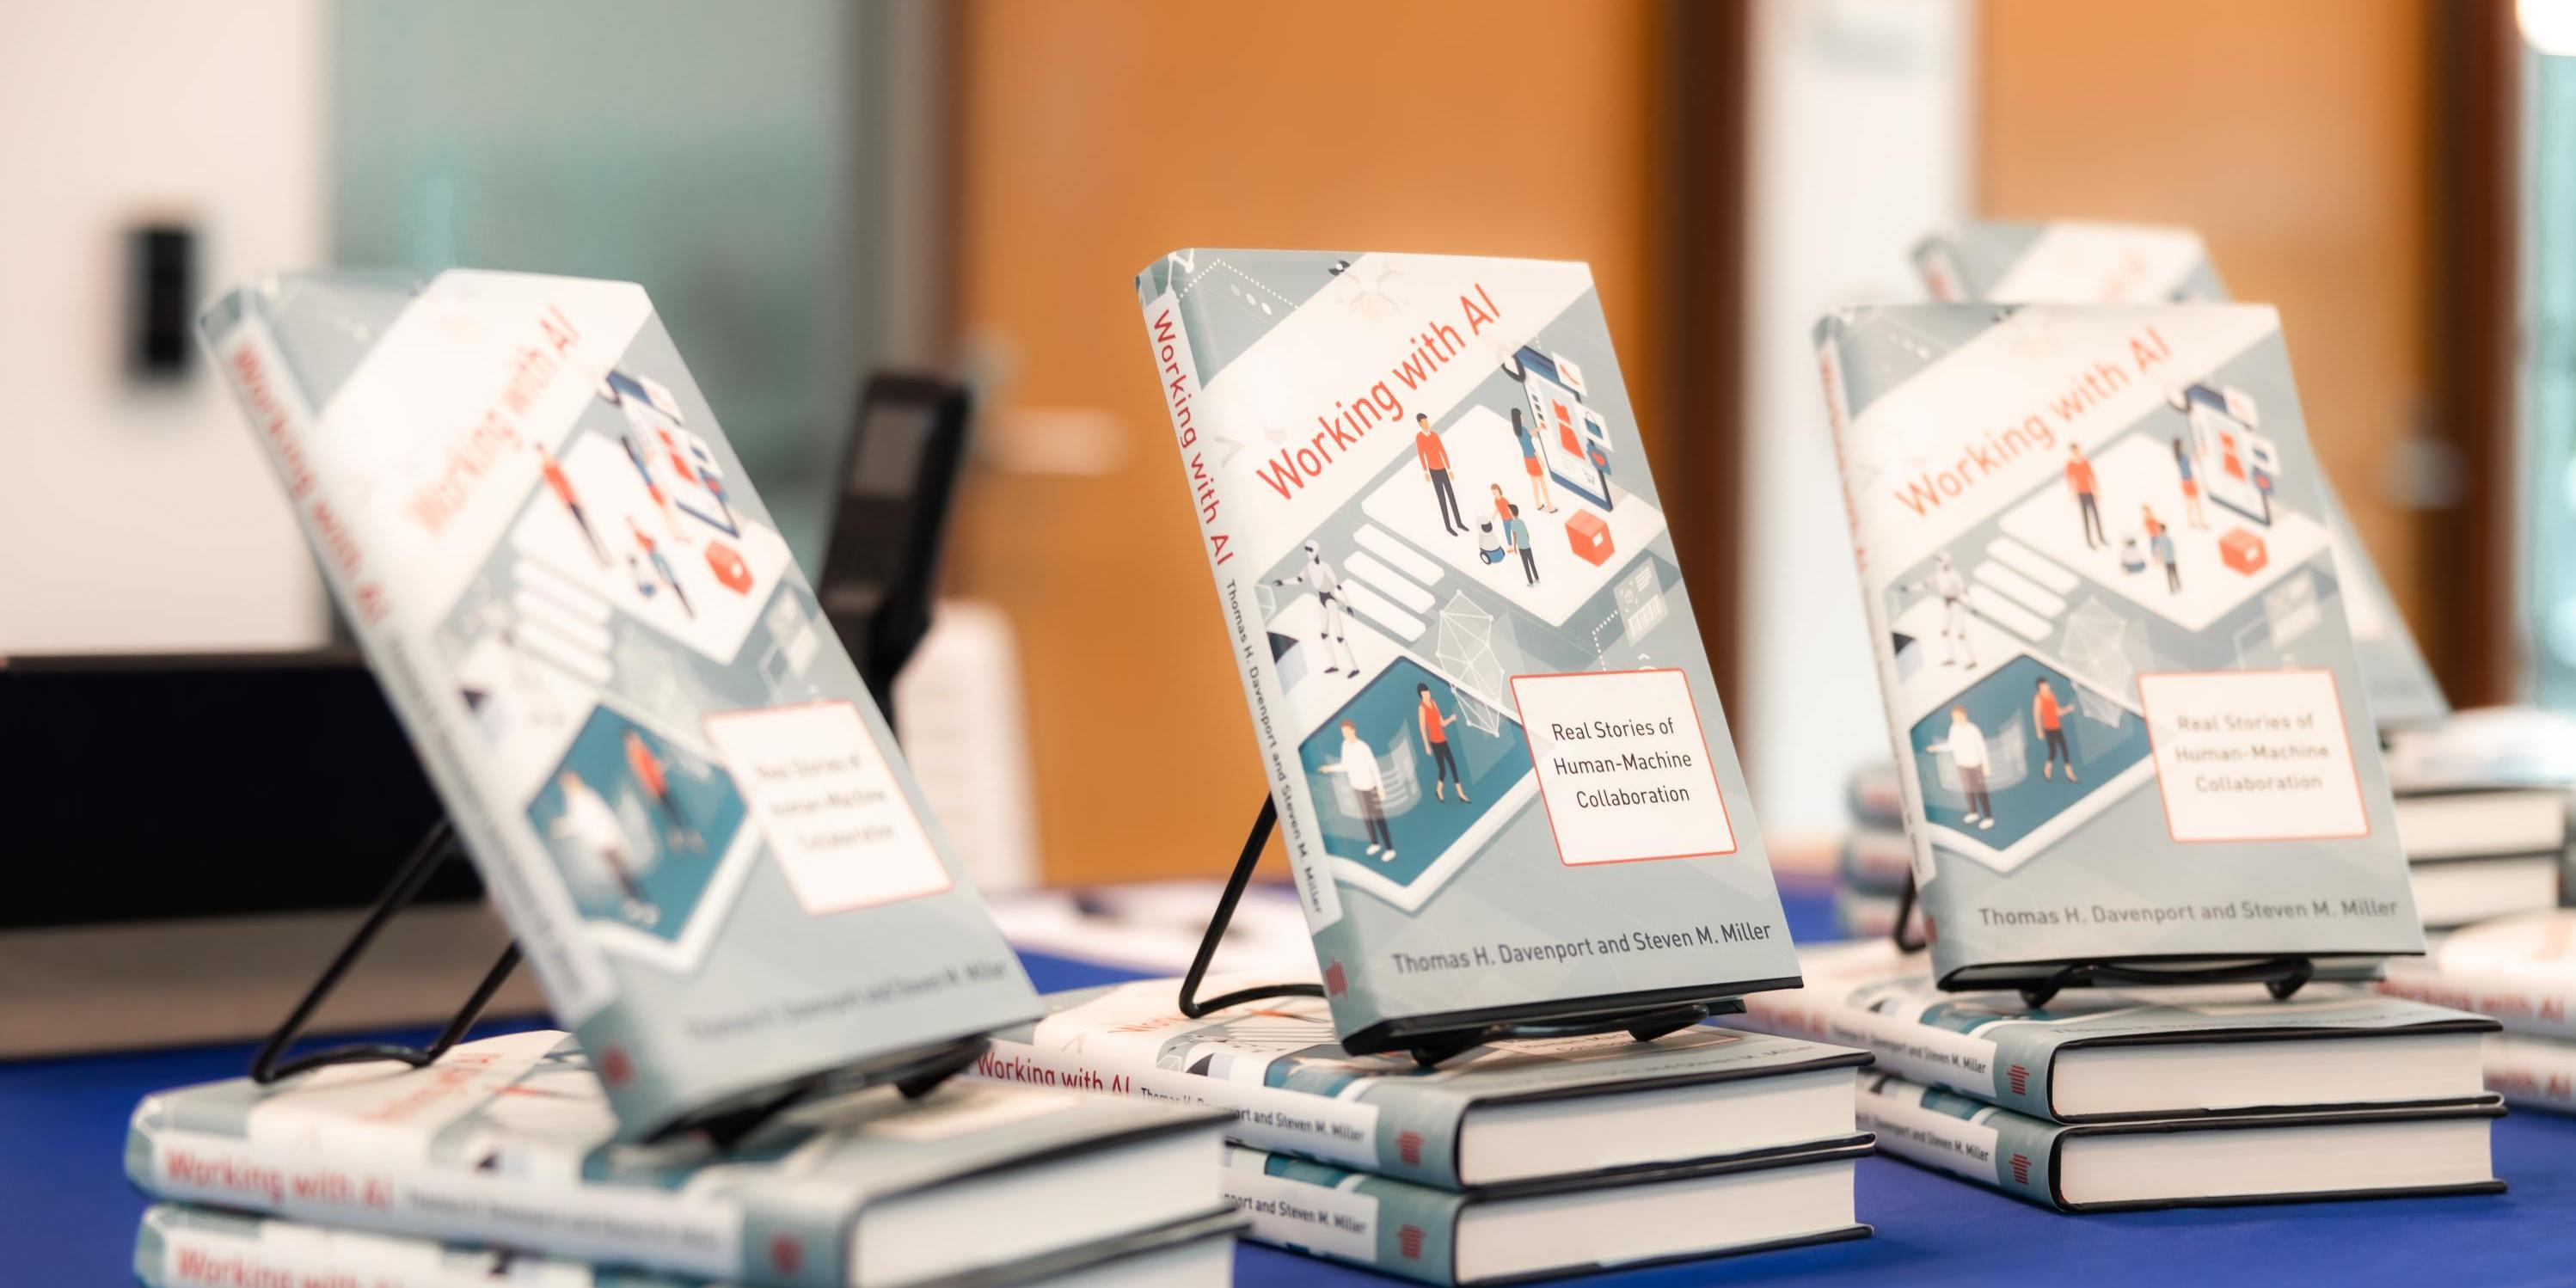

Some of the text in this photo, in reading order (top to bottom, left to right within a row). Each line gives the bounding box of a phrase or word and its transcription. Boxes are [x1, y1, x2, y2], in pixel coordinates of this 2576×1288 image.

[1256, 283, 1500, 500] Working with AI
[1894, 326, 2172, 518] Working with AI
[1154, 309, 1233, 565] Working with AI
[1552, 717, 1675, 740] Real Stories of
[2177, 714, 2314, 731] Real Stories of
[1226, 579, 1322, 914] Thomas H. Davenport and Steven M. Miller
[2174, 744, 2329, 763] Human-Machine
[1554, 751, 1692, 775] Human-Machine
[2195, 775, 2323, 794] Collaboration
[1576, 785, 1690, 808] Collaboration
[1979, 898, 2397, 928] Thomas H. Davenport and Steven M. Miller
[1392, 922, 1770, 975] Thomas H. Davenport and Steven M. Miller
[1963, 1056, 1986, 1074] Miller
[1062, 1068, 1103, 1093] with
[1254, 1110, 1273, 1125] and
[1276, 1112, 1311, 1132] Steven
[1966, 1144, 1989, 1162] Miller
[165, 1150, 393, 1211] Working with AI
[1255, 1199, 1276, 1215] and
[1279, 1201, 1315, 1220] Steven
